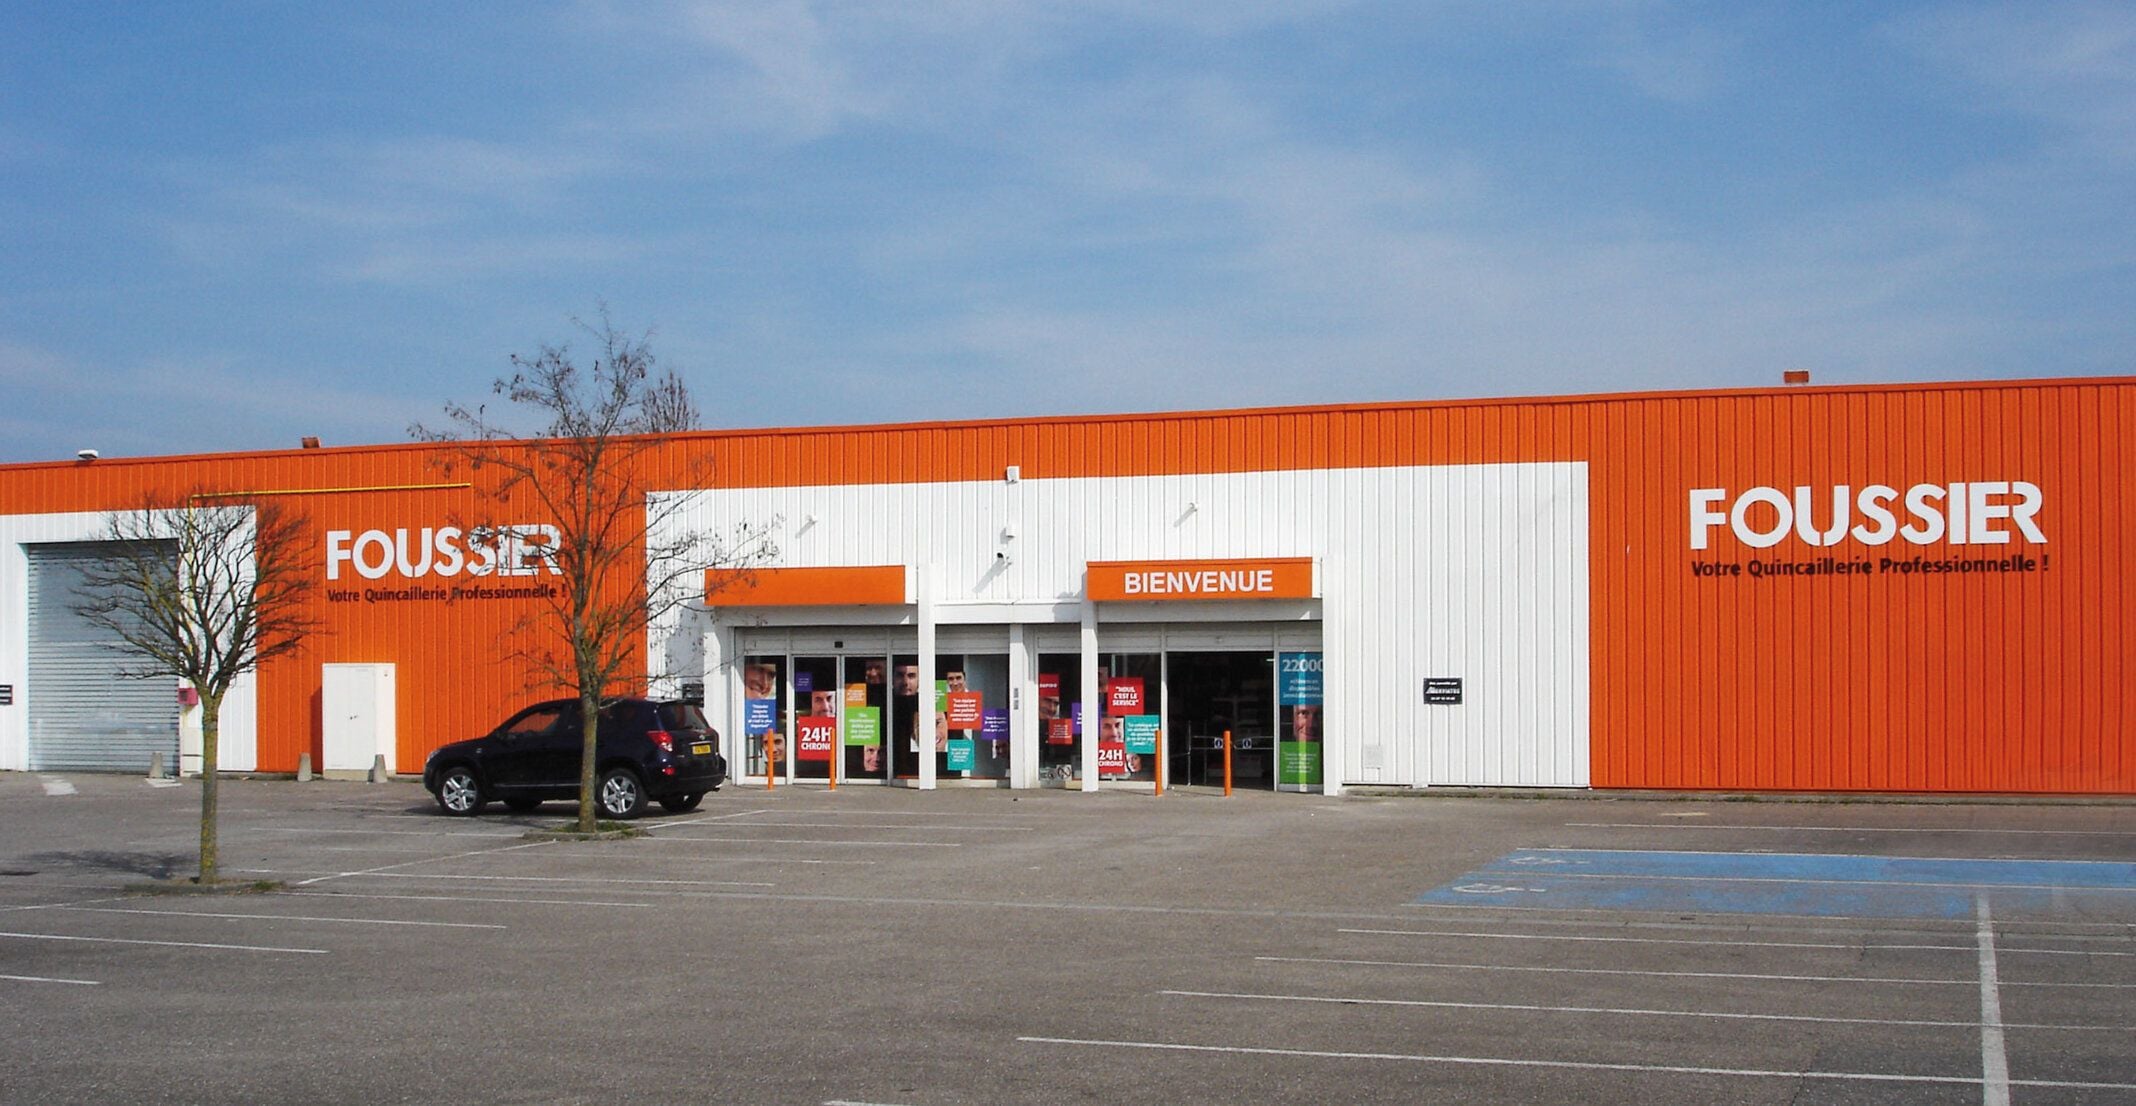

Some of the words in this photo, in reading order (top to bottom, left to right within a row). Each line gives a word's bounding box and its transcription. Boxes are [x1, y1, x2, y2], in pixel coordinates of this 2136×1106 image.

[1689, 481, 2048, 550] FOUSSIER
[326, 524, 564, 580] FOUSSIER
[1691, 561, 1741, 576] Votre
[1747, 556, 1872, 578] Quincaillerie
[1880, 554, 2036, 574] Professionnelle
[2043, 554, 2049, 571] !
[327, 588, 360, 602] Votre
[364, 585, 447, 604] Quincaillerie
[451, 583, 557, 600] Professionnelle
[1124, 570, 1273, 594] BIENVENUE
[801, 726, 832, 742] 24H
[1098, 749, 1123, 760] 24H
